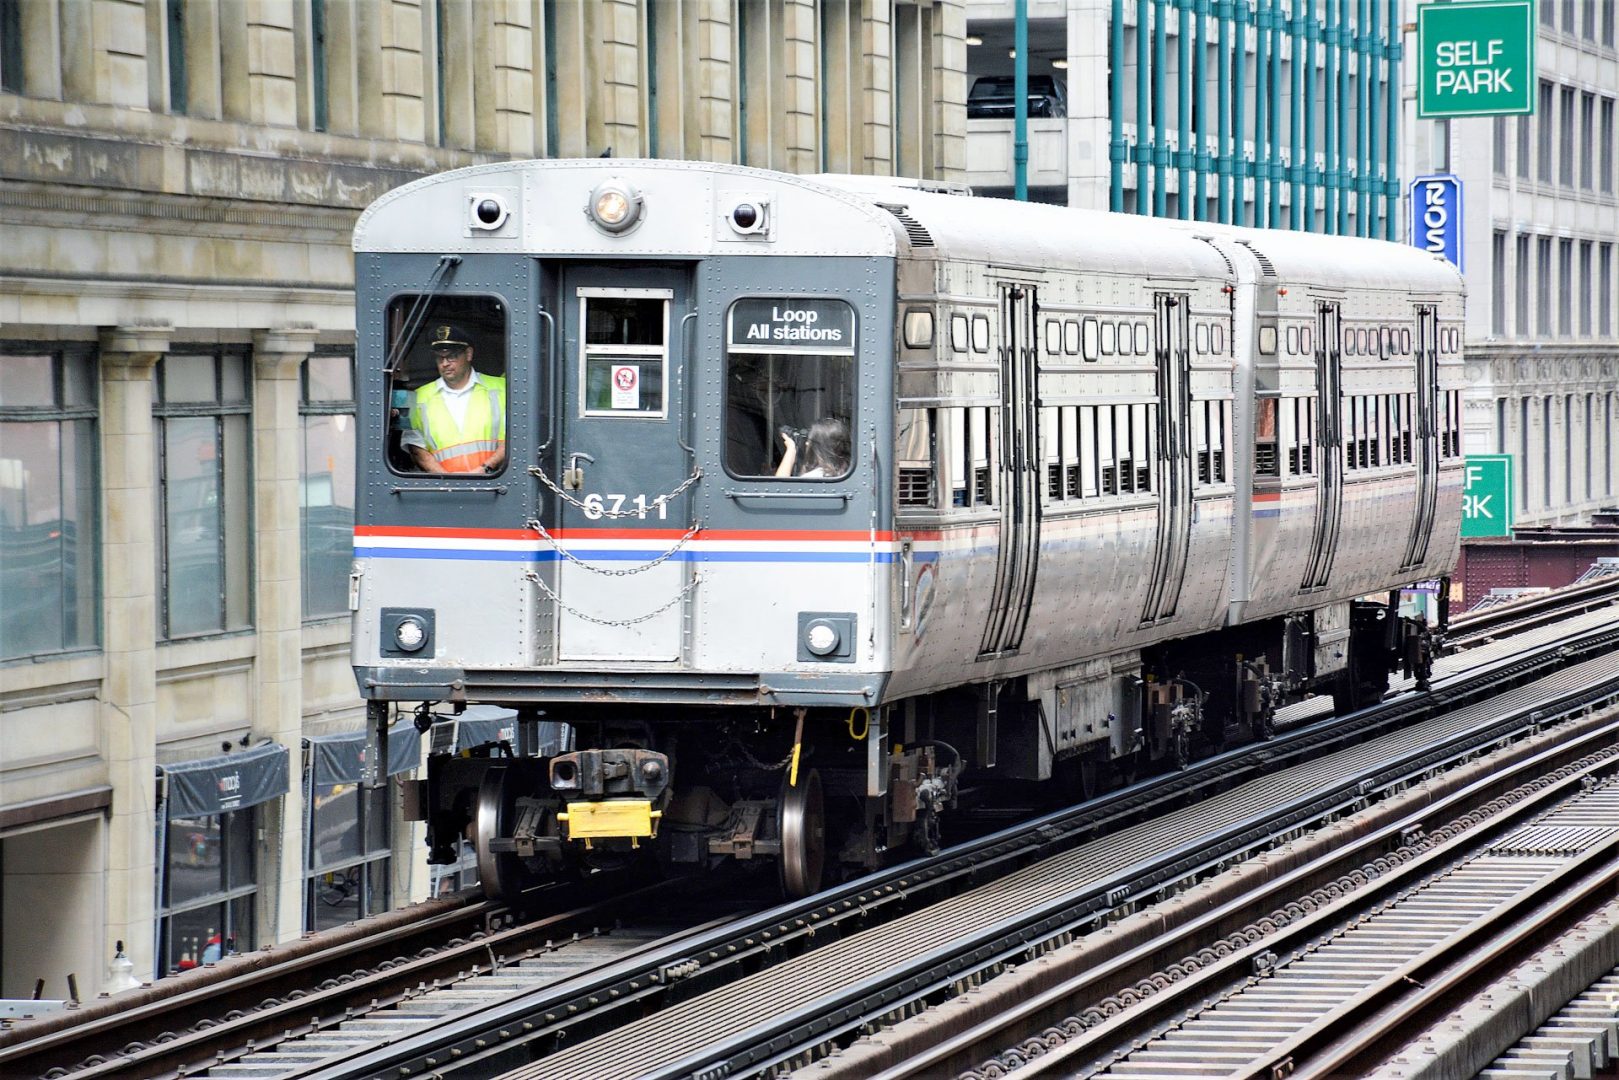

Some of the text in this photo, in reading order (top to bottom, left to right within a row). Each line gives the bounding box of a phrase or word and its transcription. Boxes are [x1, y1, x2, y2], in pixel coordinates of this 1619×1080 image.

[1436, 39, 1504, 67] SELF
[1436, 67, 1513, 96] PARK
[1424, 182, 1447, 257] ROS
[772, 306, 818, 325] Loop
[747, 324, 842, 340] All stations
[583, 493, 667, 520] 6711
